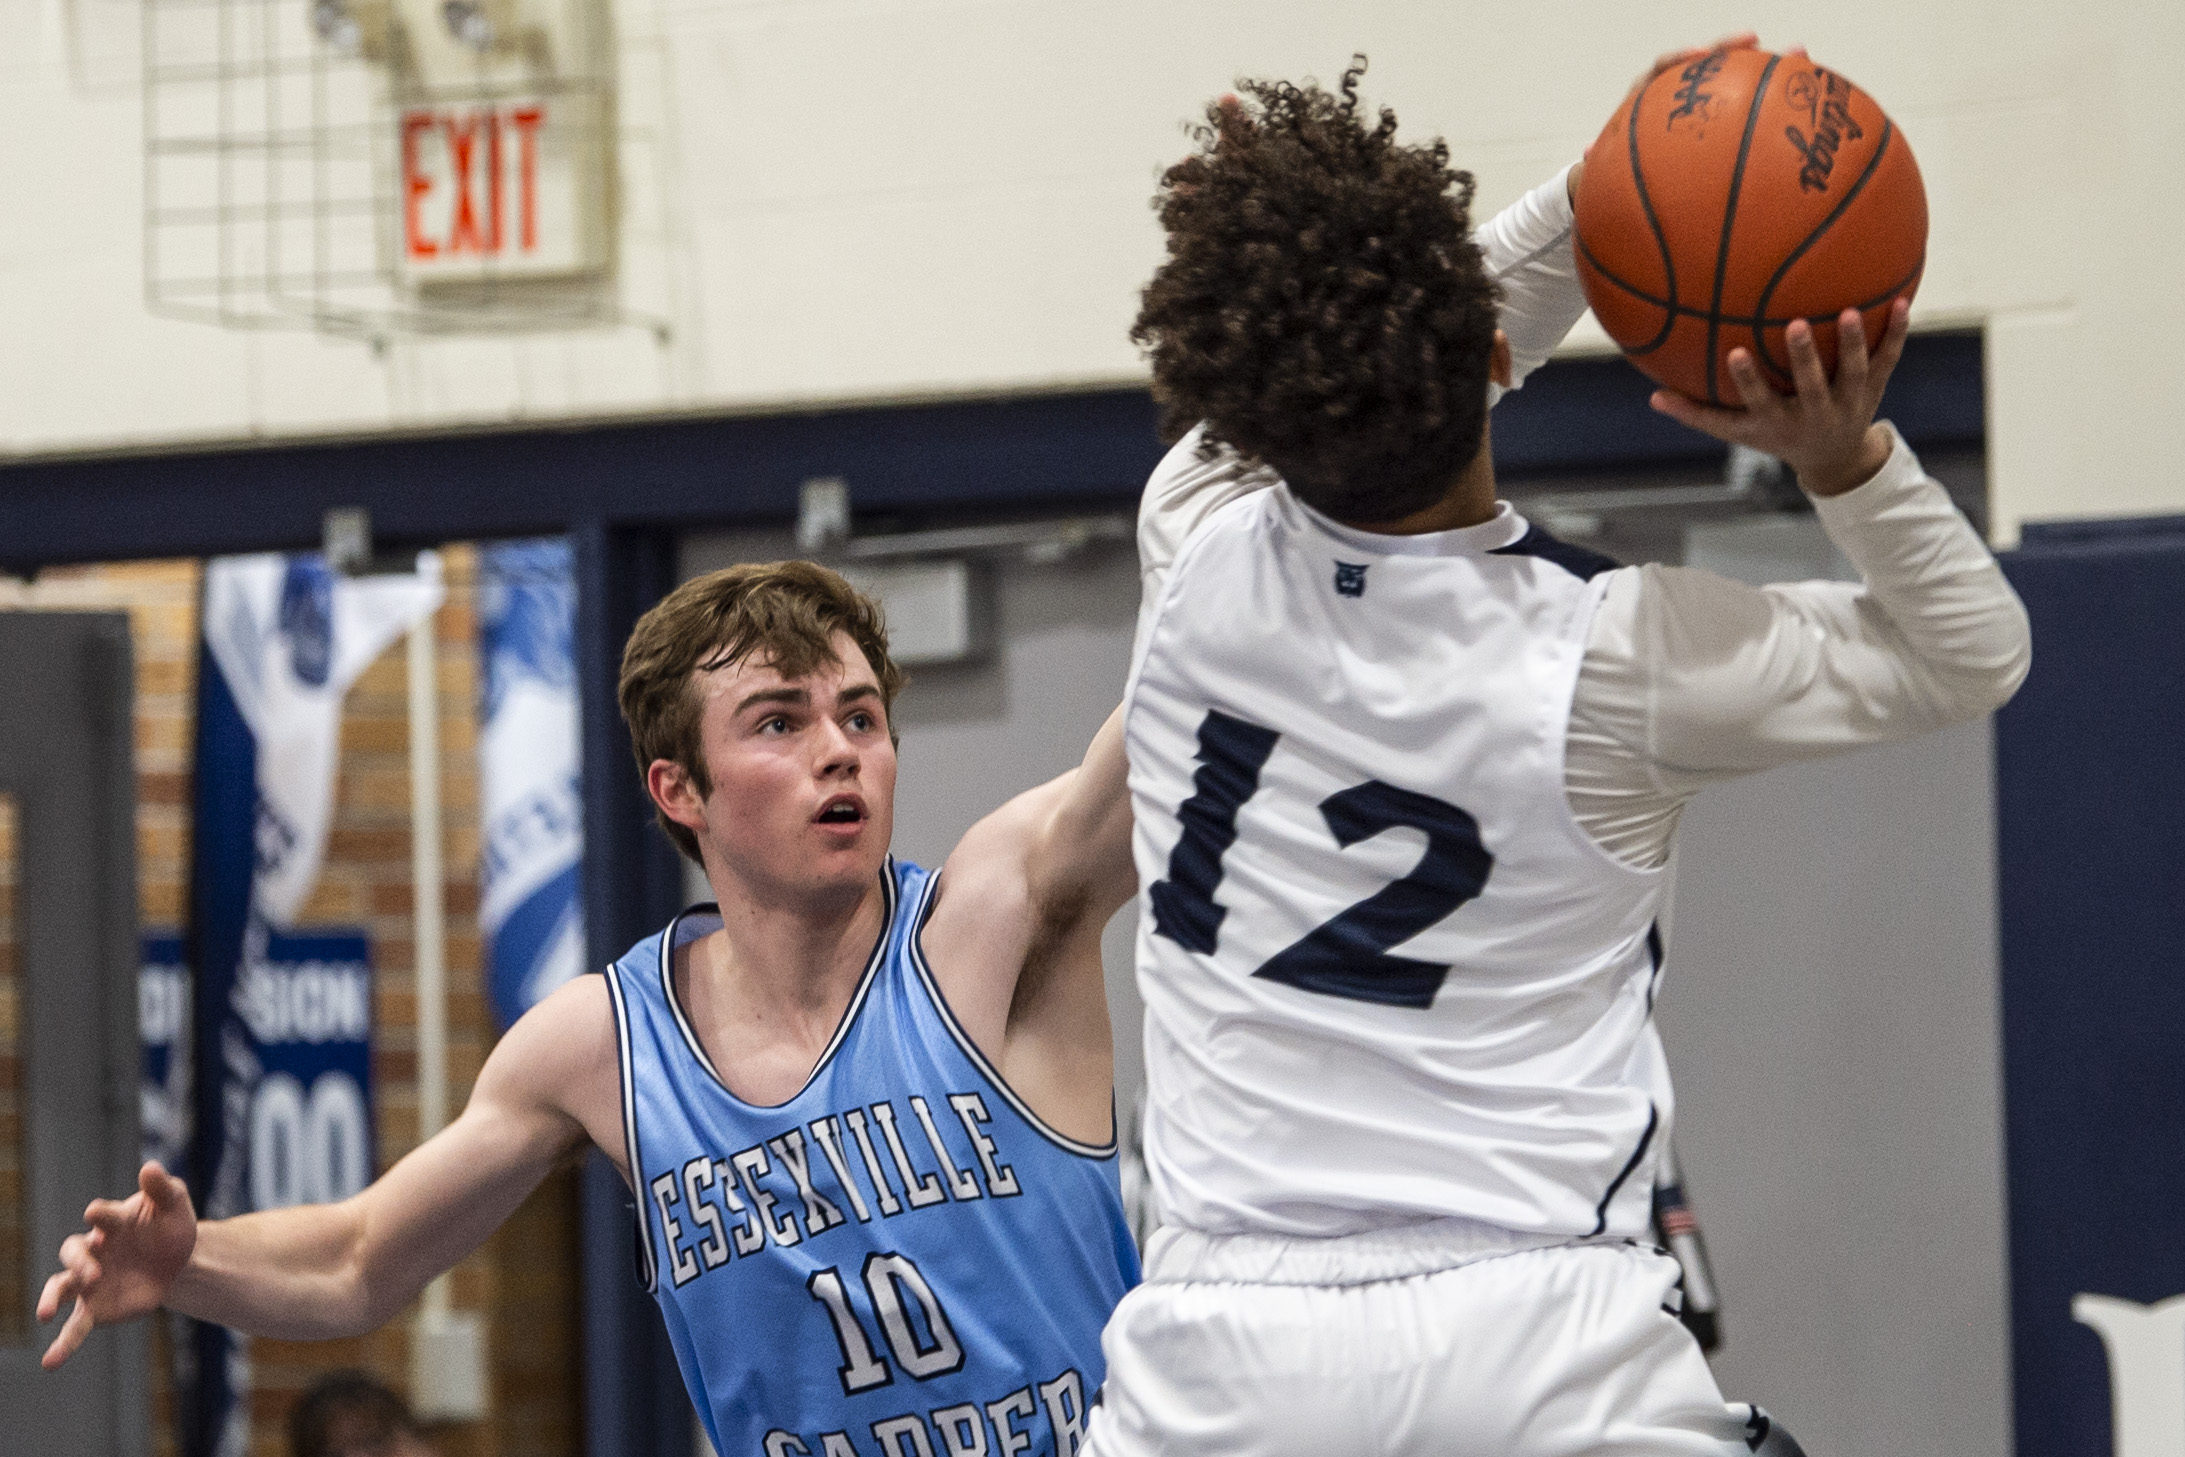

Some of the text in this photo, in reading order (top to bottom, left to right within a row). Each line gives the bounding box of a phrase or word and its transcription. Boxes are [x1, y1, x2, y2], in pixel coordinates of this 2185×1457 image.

[401, 108, 545, 260] EXIT
[1149, 708, 1495, 1010] 12
[651, 1093, 1023, 1288] ESSEXVILLE
[805, 1250, 966, 1396] 10
